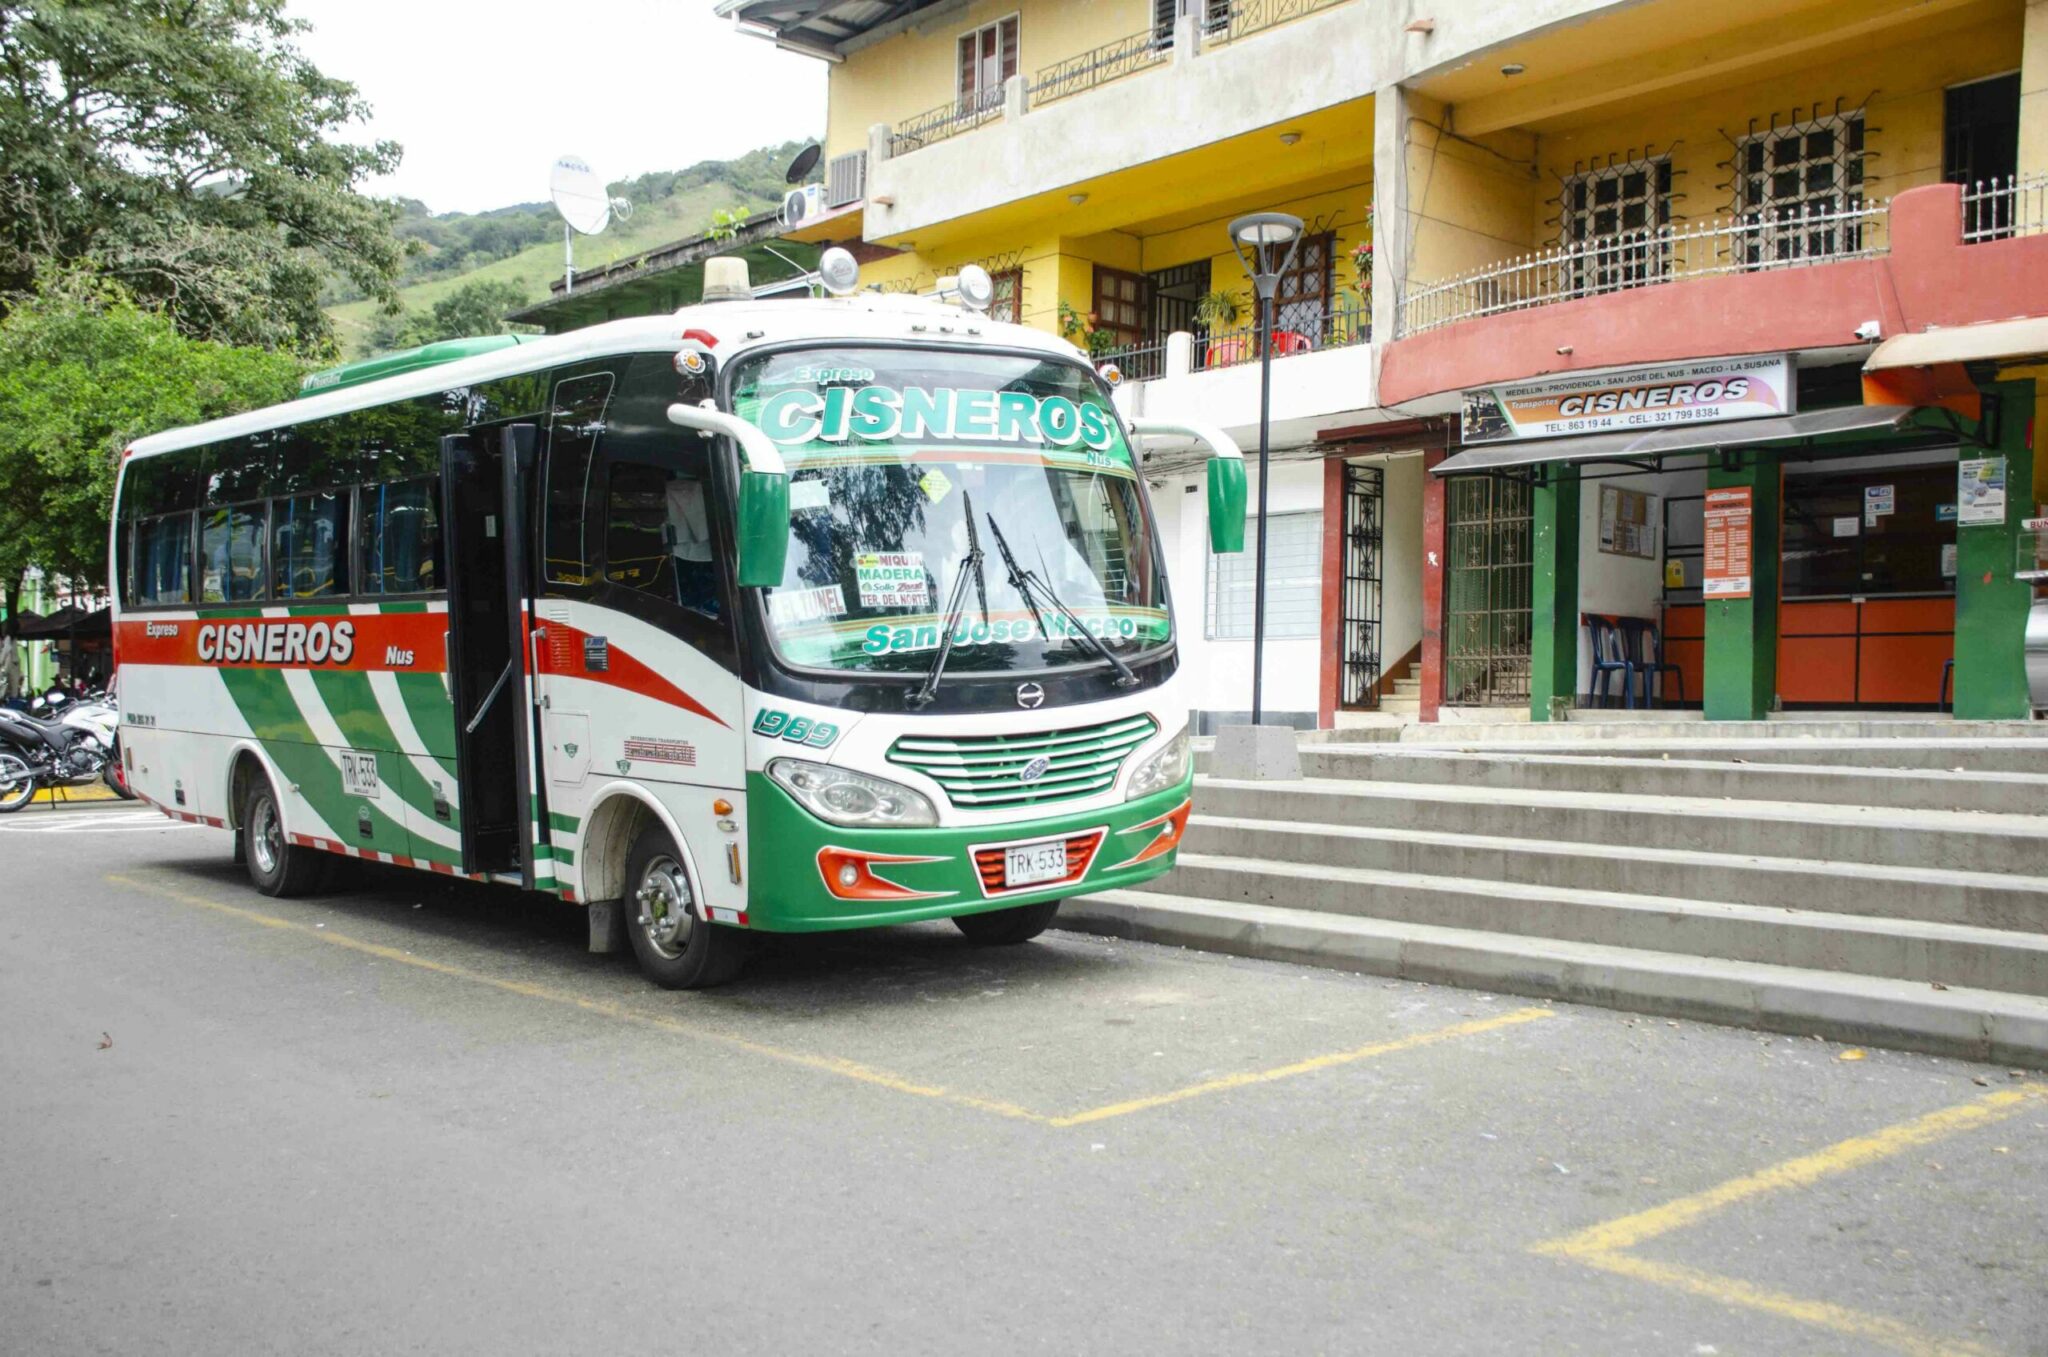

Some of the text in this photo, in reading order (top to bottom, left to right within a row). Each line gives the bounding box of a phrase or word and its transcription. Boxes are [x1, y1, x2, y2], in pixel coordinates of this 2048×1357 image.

[795, 367, 876, 385] Expreso
[1506, 359, 1781, 397] MEDELLIN PROVIDENCIA SAN JOSE DEL NUS MACEO LA SUSANA
[1511, 398, 1558, 409] Transportes
[1559, 377, 1749, 417] CISNEROS
[760, 386, 1113, 450] CISNEROS
[1568, 420, 1585, 430] 863
[1588, 419, 1599, 428] 19
[1600, 418, 1612, 427] 44
[1656, 412, 1672, 421] 321
[1675, 410, 1693, 419] 799
[1695, 407, 1719, 417] 8384
[1087, 451, 1113, 467] Nus
[859, 568, 924, 580] MADERA
[882, 594, 899, 606] DEL
[900, 593, 929, 606] NORTE
[146, 621, 178, 638] Expreso
[863, 612, 1137, 655] San Jose Maceo
[197, 621, 355, 663] CISNEROS
[385, 645, 414, 666] Nus
[752, 707, 840, 750] 1989
